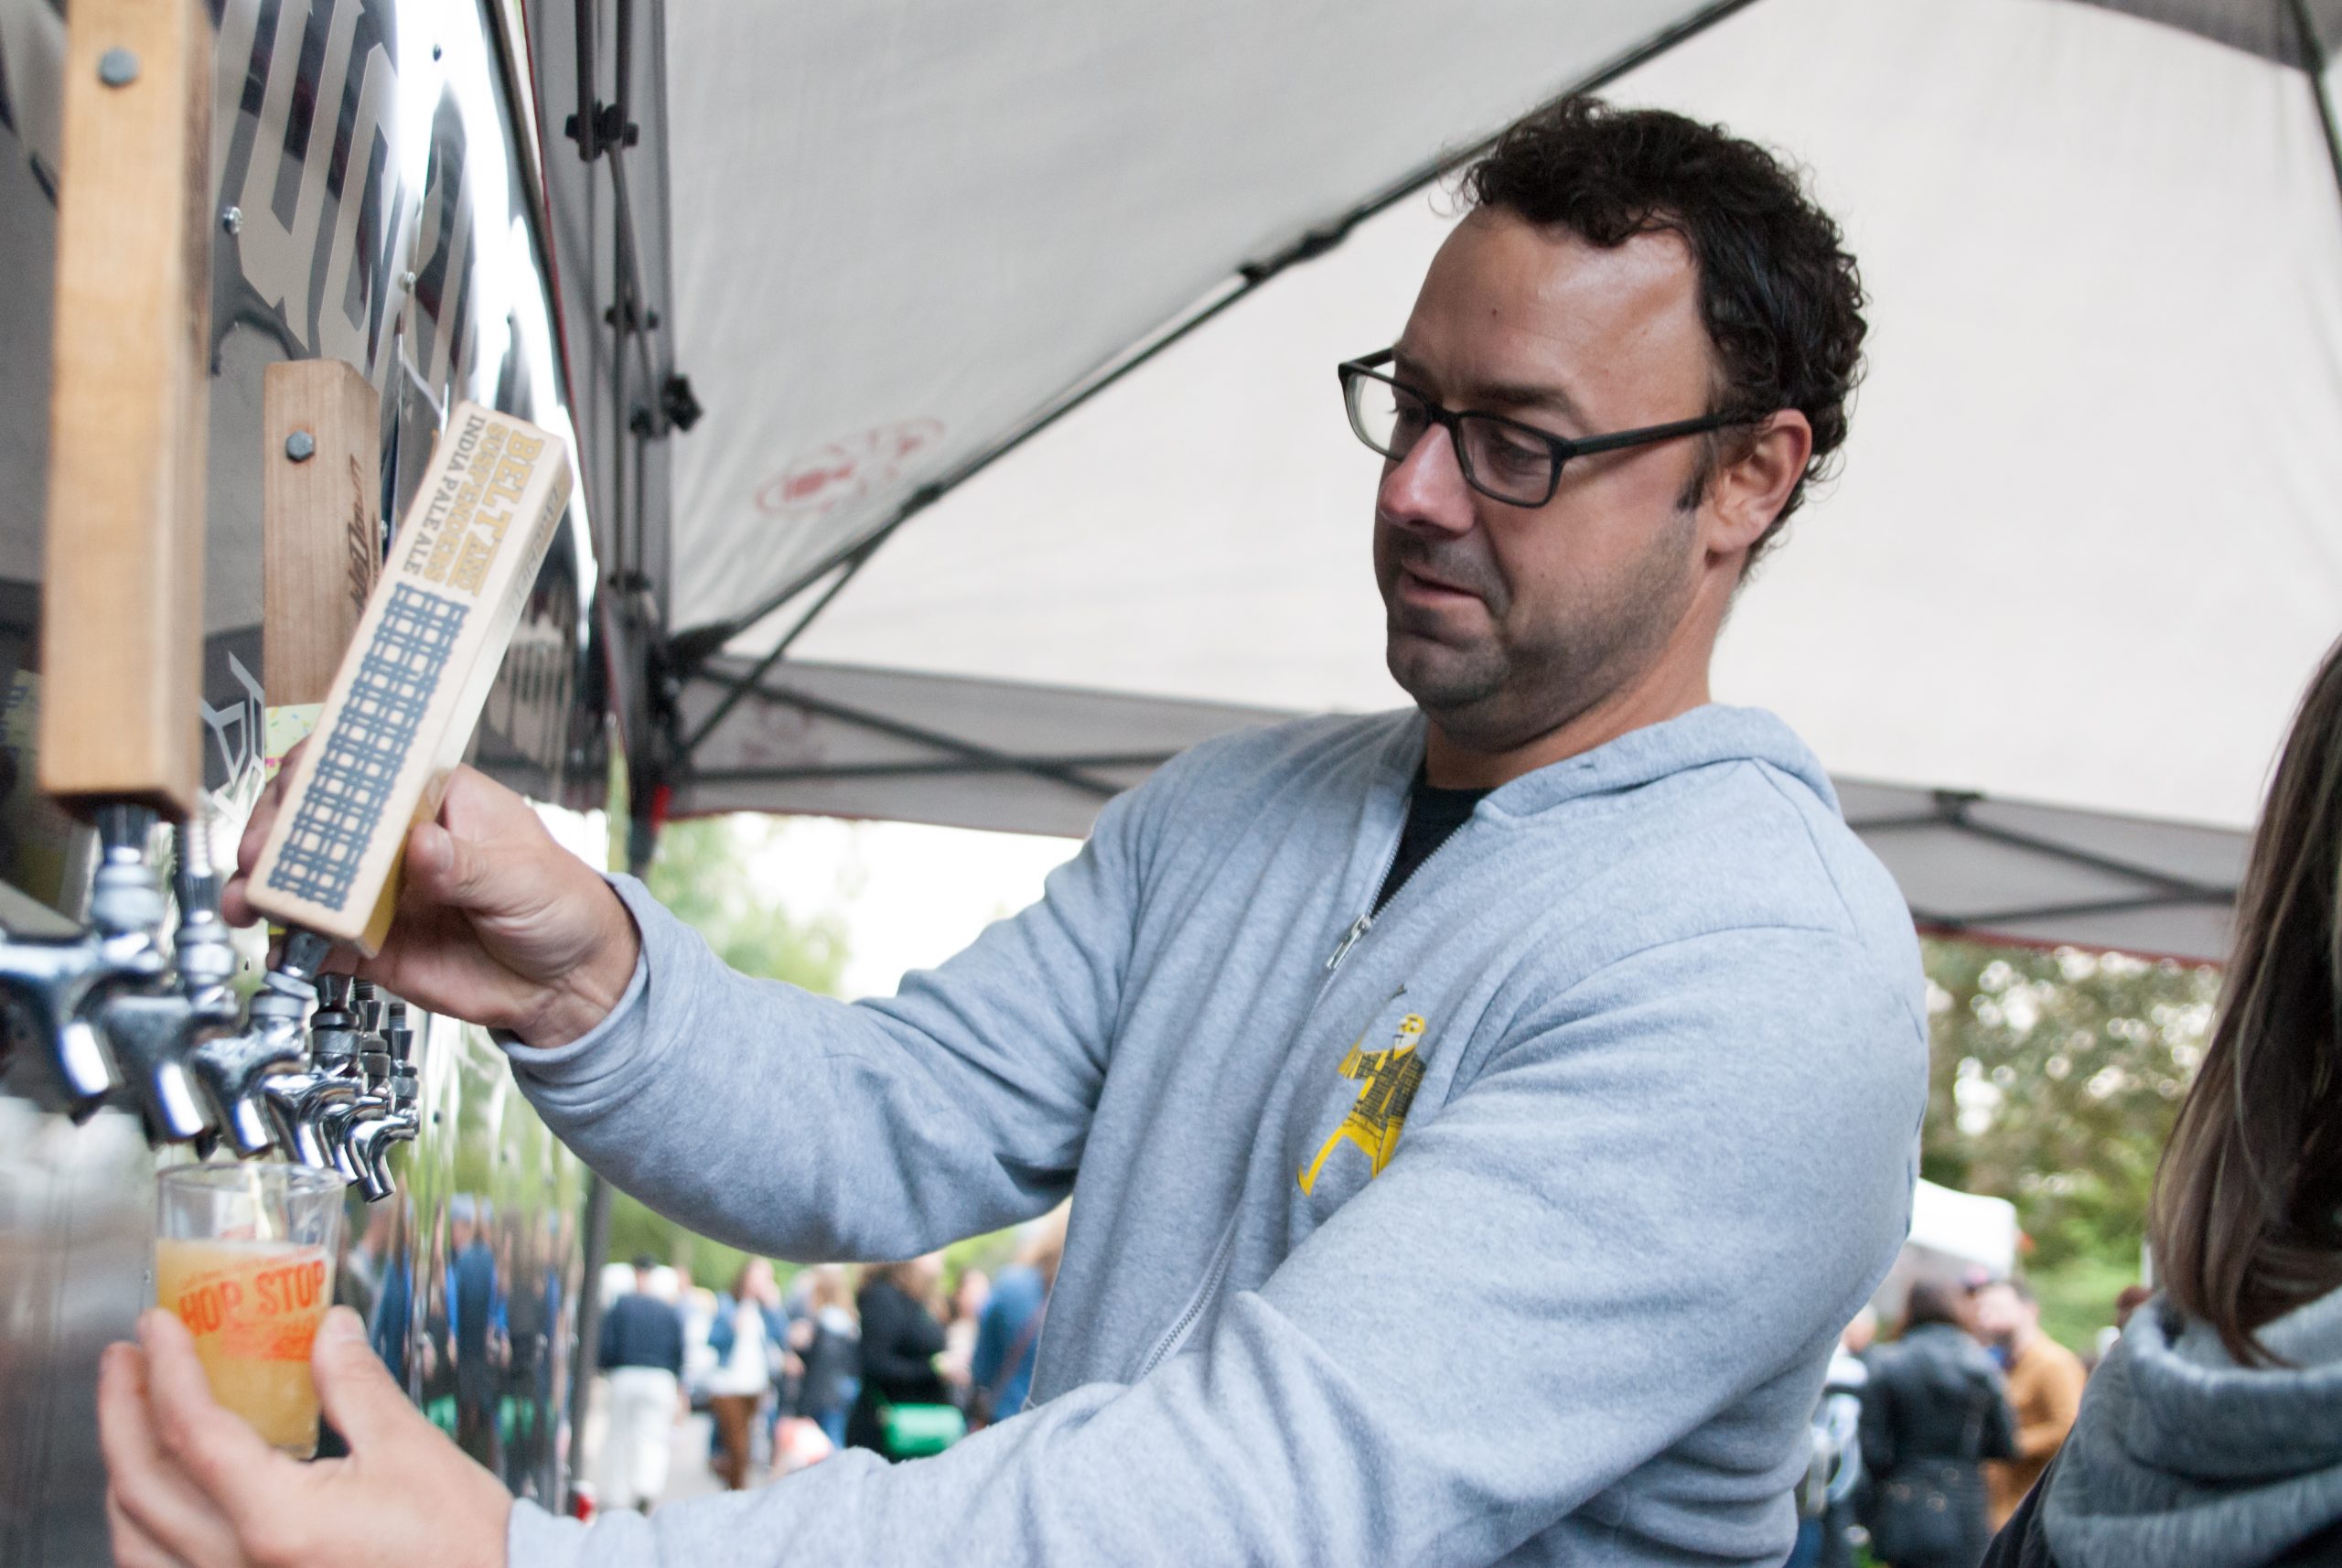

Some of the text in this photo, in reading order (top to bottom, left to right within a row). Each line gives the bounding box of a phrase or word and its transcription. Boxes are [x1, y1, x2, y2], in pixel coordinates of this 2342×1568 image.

[403, 413, 487, 576] INDIA PALE ALE
[424, 422, 510, 583] SUSPENDERS
[473, 431, 545, 542] BELT
[450, 531, 500, 596] AND
[178, 1280, 243, 1337] HOP
[255, 1259, 327, 1316] STOP
